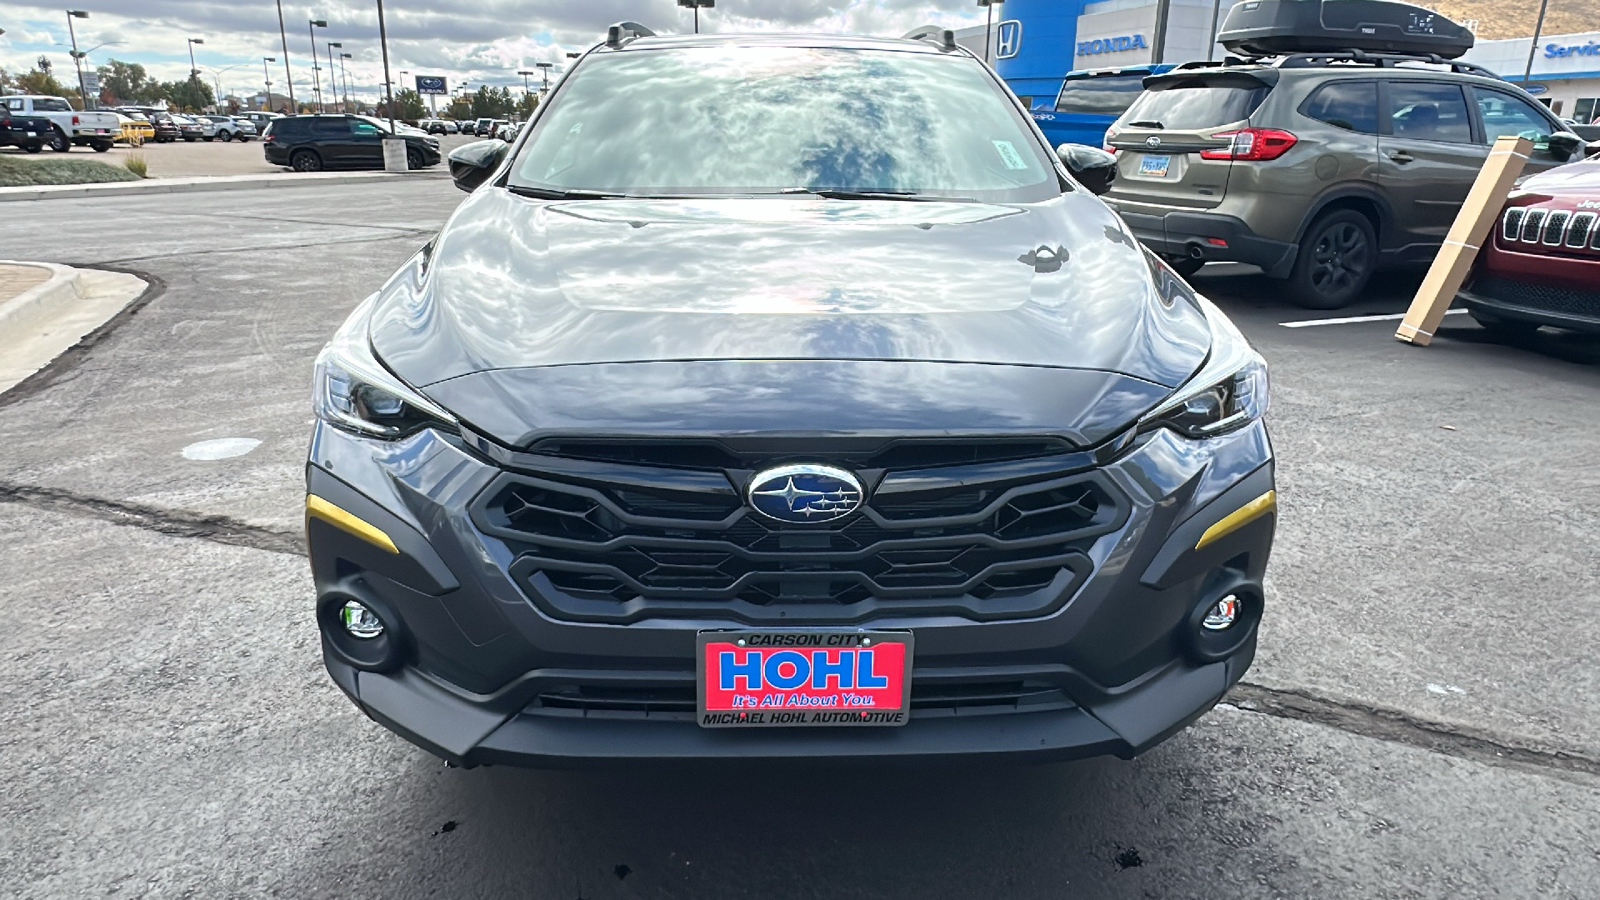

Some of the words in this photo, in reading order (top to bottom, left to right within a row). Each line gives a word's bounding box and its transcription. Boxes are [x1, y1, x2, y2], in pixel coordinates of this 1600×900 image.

[1077, 34, 1147, 56] HONDA
[1577, 200, 1600, 210] Jee
[748, 634, 823, 646] CARSON
[827, 634, 867, 646] CITY
[719, 650, 888, 691] HOHL
[732, 694, 758, 707] It's
[760, 693, 785, 707] All
[786, 693, 838, 707] About
[703, 712, 765, 724] MICHAEL
[770, 712, 808, 723] HOHL
[812, 712, 904, 723] AUTOMOTIVE
